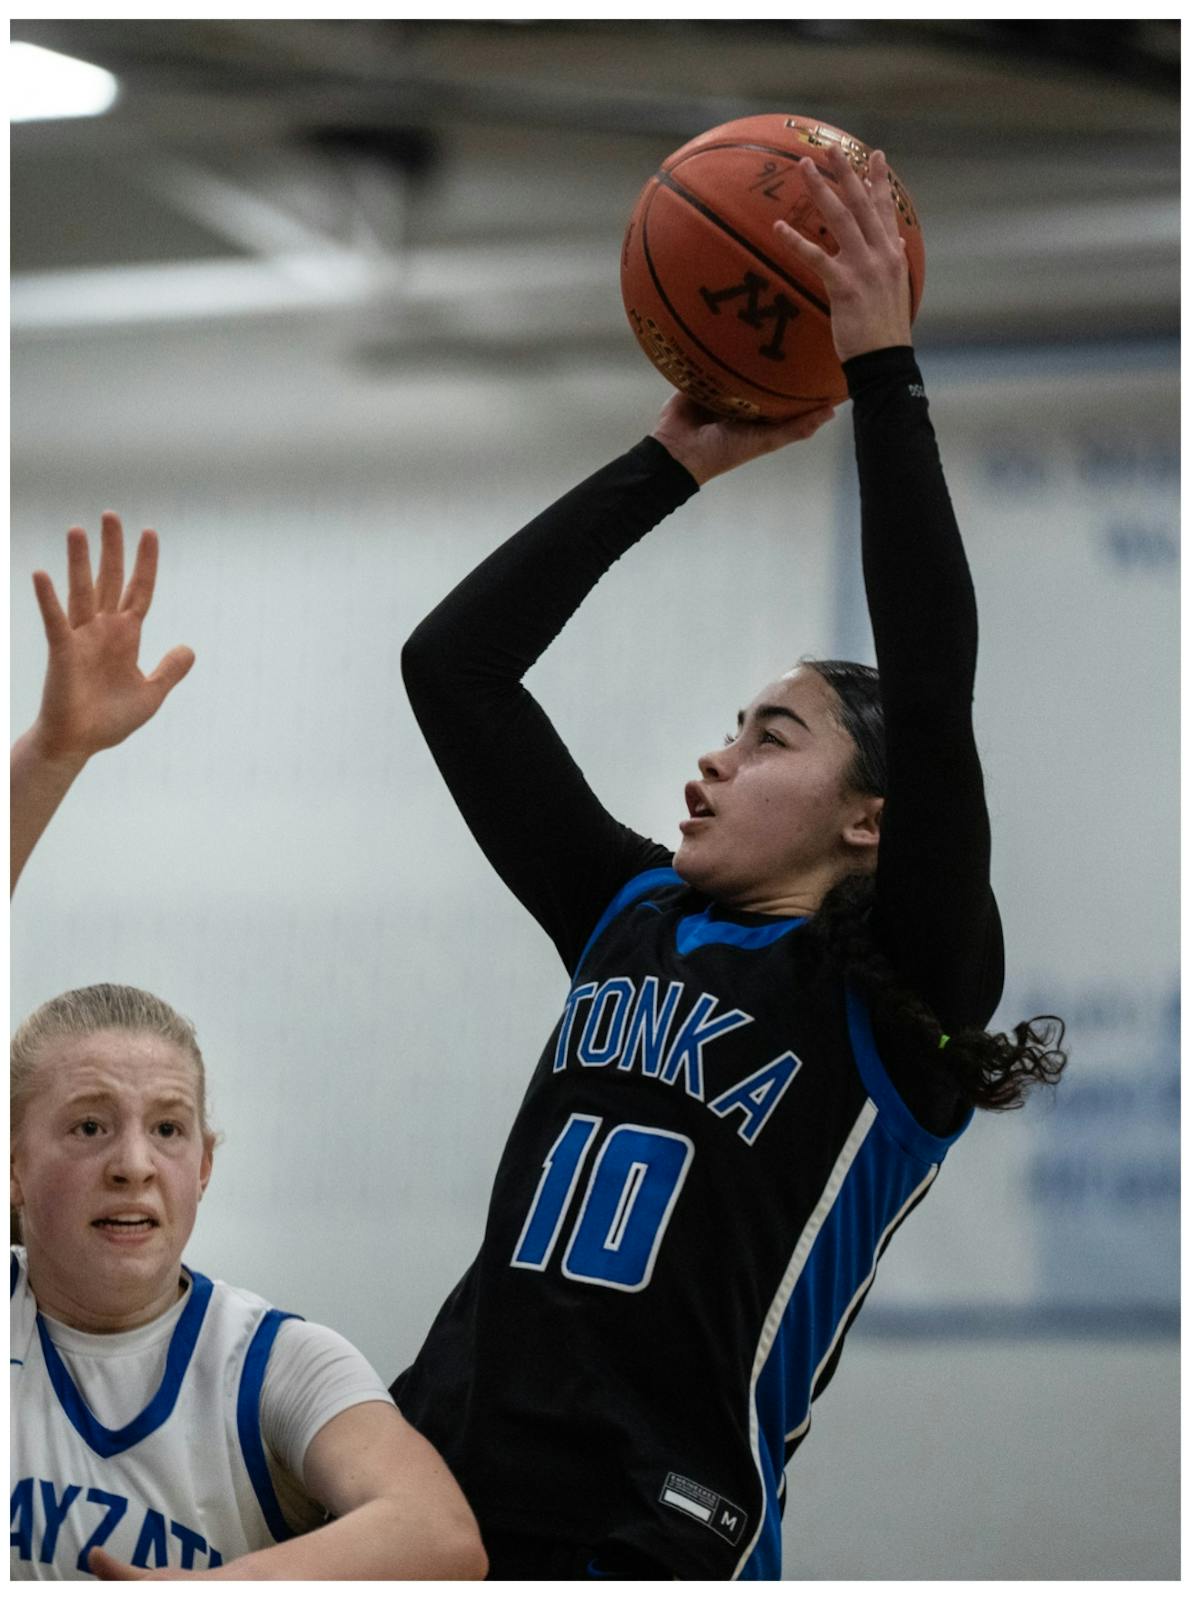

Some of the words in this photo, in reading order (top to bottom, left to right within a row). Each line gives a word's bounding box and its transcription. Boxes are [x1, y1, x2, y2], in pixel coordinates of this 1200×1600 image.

[552, 975, 803, 1147] TONKA
[510, 1112, 696, 1293] 10
[721, 1510, 738, 1532] M
